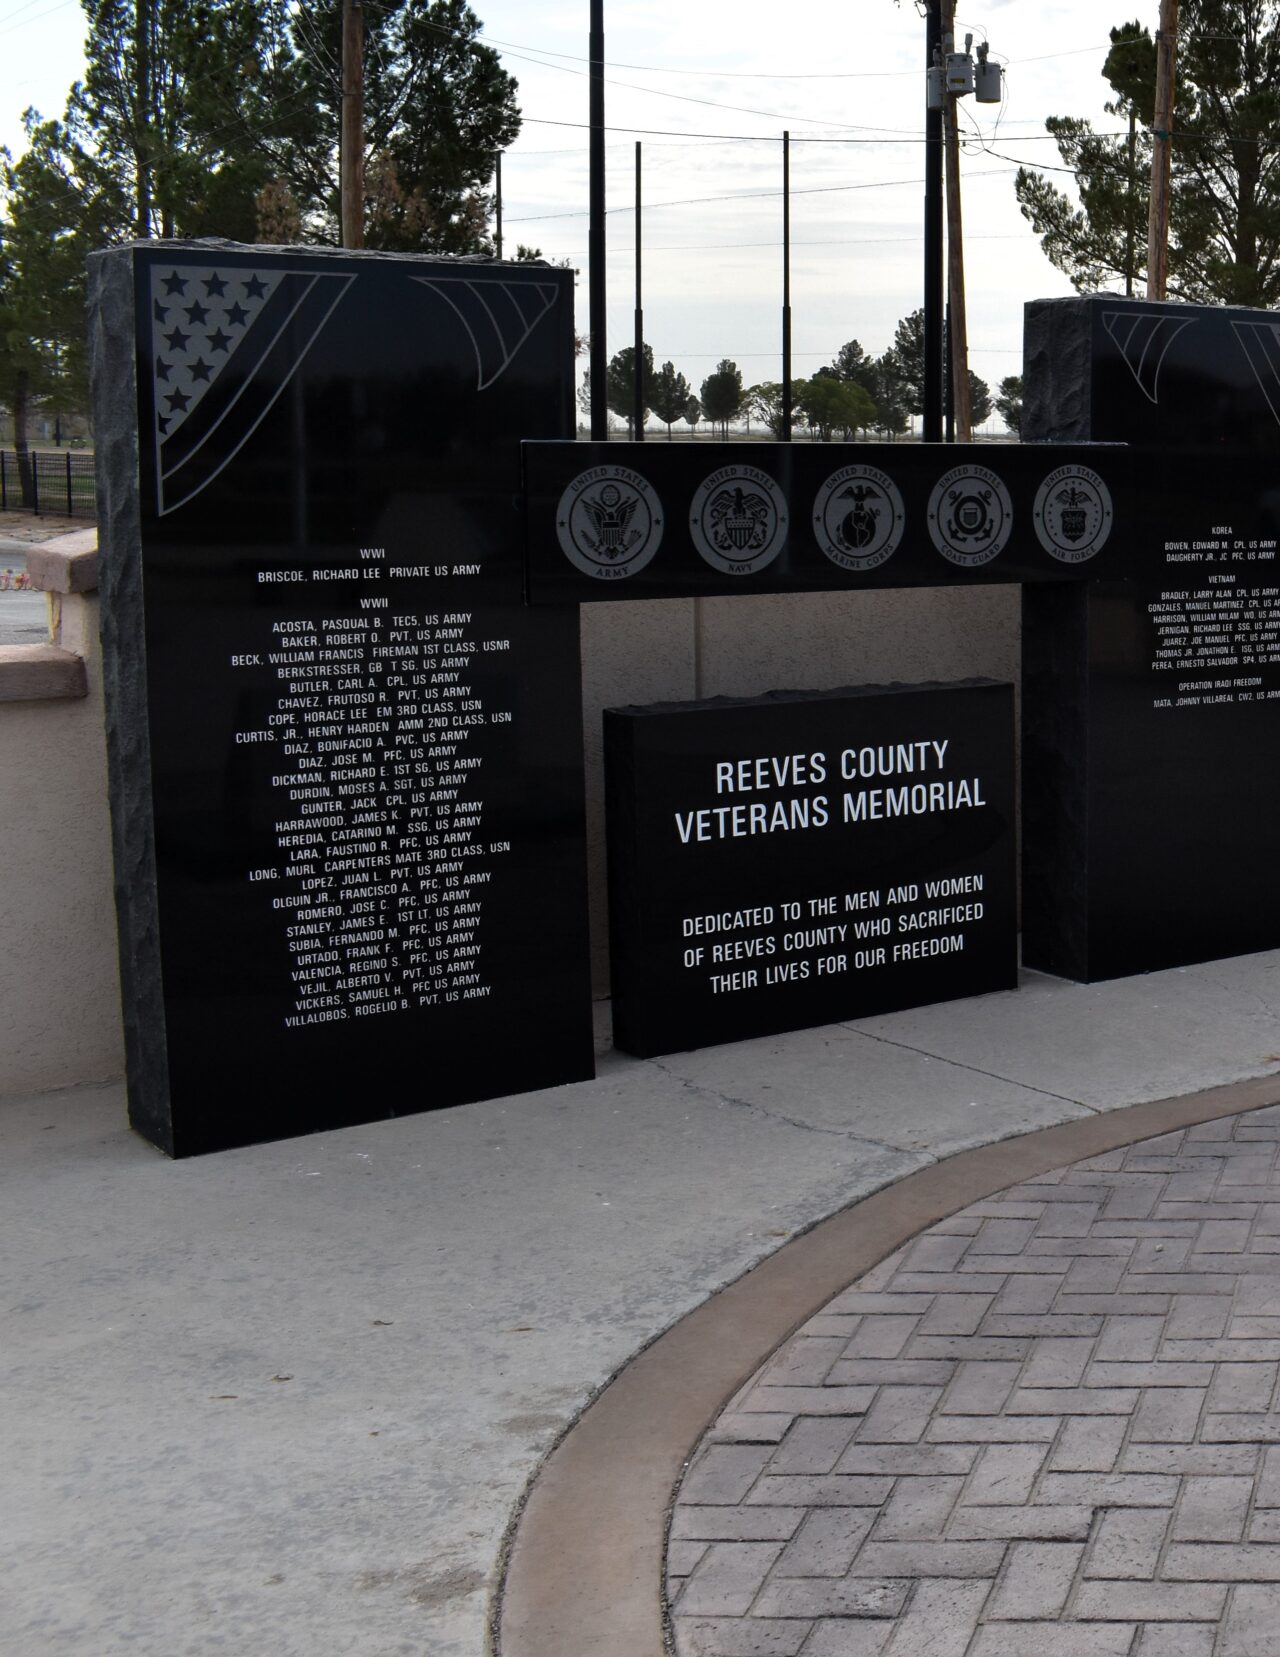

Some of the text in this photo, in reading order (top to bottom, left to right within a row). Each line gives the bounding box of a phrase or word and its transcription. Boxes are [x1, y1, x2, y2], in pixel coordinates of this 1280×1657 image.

[571, 468, 649, 493] UNITED STATES
[704, 468, 775, 490] UNITED STATES
[826, 467, 892, 490] UNITED STATES
[939, 467, 1001, 489] UNITED STATES
[1044, 466, 1102, 488] UNITED STATES
[359, 548, 385, 559] WWI
[941, 543, 1000, 564] COAST GUARD
[1052, 546, 1096, 560] AIR FORCE
[1248, 540, 1257, 549] US
[1259, 540, 1277, 548] ARMY
[825, 544, 894, 568] MARINE CORPS
[312, 568, 359, 580] RICHARD
[363, 567, 380, 579] LEE
[389, 566, 430, 577] PRIVATE
[434, 565, 448, 576] US
[452, 564, 481, 575] ARMY
[596, 567, 629, 578] ARMY
[728, 563, 753, 572] NAVY
[360, 597, 388, 609] WWII
[1251, 588, 1260, 597] US
[1261, 587, 1279, 596] ARMY
[322, 617, 370, 630] PASQUAL
[425, 614, 439, 625] US
[443, 612, 472, 624] ARMY
[1254, 621, 1263, 630] US
[1258, 610, 1267, 619] US
[268, 650, 314, 664] WILLIAM
[318, 647, 364, 661] FRANCIS
[372, 645, 418, 657] FIREMAN
[423, 643, 439, 655] 1ST
[482, 639, 510, 651] USNR
[337, 678, 364, 690] CARL
[412, 673, 426, 685] US
[430, 671, 459, 684] ARMY
[1256, 691, 1265, 700] US
[304, 709, 346, 722] HORACE
[350, 707, 367, 719] LEE
[376, 706, 392, 717] EM
[396, 704, 417, 716] 3RD
[461, 699, 482, 711] USN
[331, 753, 358, 766] JOSE
[409, 747, 424, 759] US
[427, 744, 457, 757] ARMY
[716, 739, 949, 794] REEVES COUNTY
[350, 797, 377, 809] JACK
[411, 792, 425, 803] US
[429, 789, 458, 801] ARMY
[674, 778, 986, 844] VETERANS MEMORIAL
[285, 863, 316, 877] MURL
[324, 854, 391, 872] CARPENTERS
[395, 851, 422, 864] MATE
[426, 848, 447, 860] 3RD
[490, 841, 510, 853] USN
[682, 874, 984, 937] DEDICATED TO THE MEN AND WOMEN
[684, 902, 984, 968] OF REEVES COUNTY WHO SACRIFICED
[710, 934, 964, 994] THEIR LIVES FOR OUR FREEDOM
[355, 1000, 397, 1016] ROGELIO
[445, 990, 459, 1002] US
[463, 985, 491, 999] ARMY
